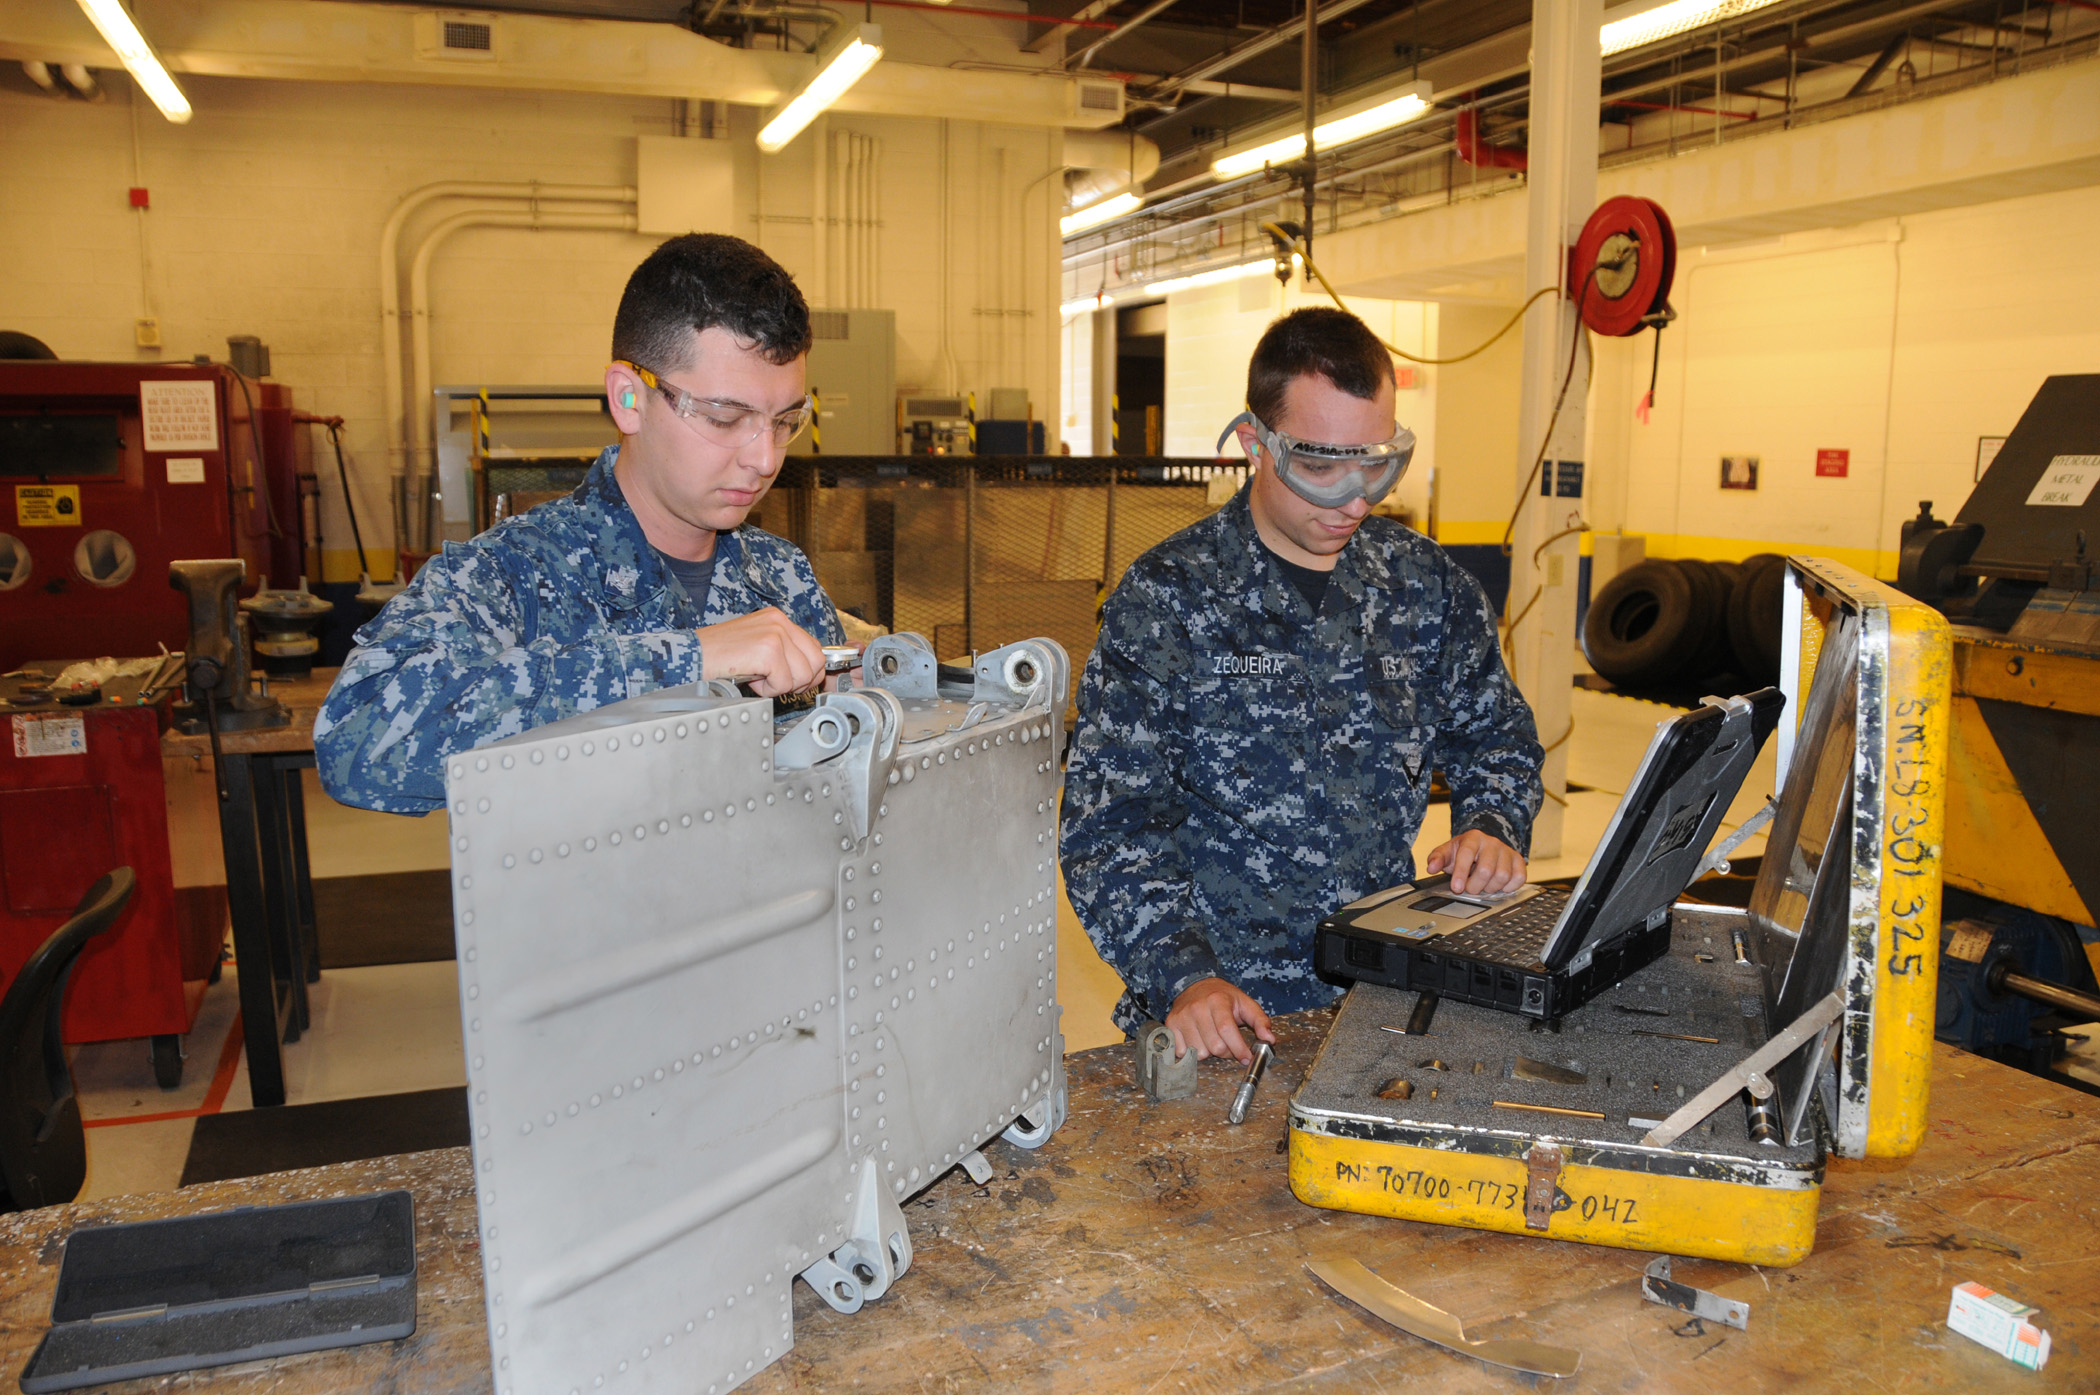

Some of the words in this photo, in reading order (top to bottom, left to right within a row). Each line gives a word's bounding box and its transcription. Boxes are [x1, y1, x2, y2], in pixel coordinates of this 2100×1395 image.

[2051, 474, 2084, 484] METAL
[2041, 492, 2071, 502] BREAK
[1213, 655, 1284, 675] ZEQUEIRA
